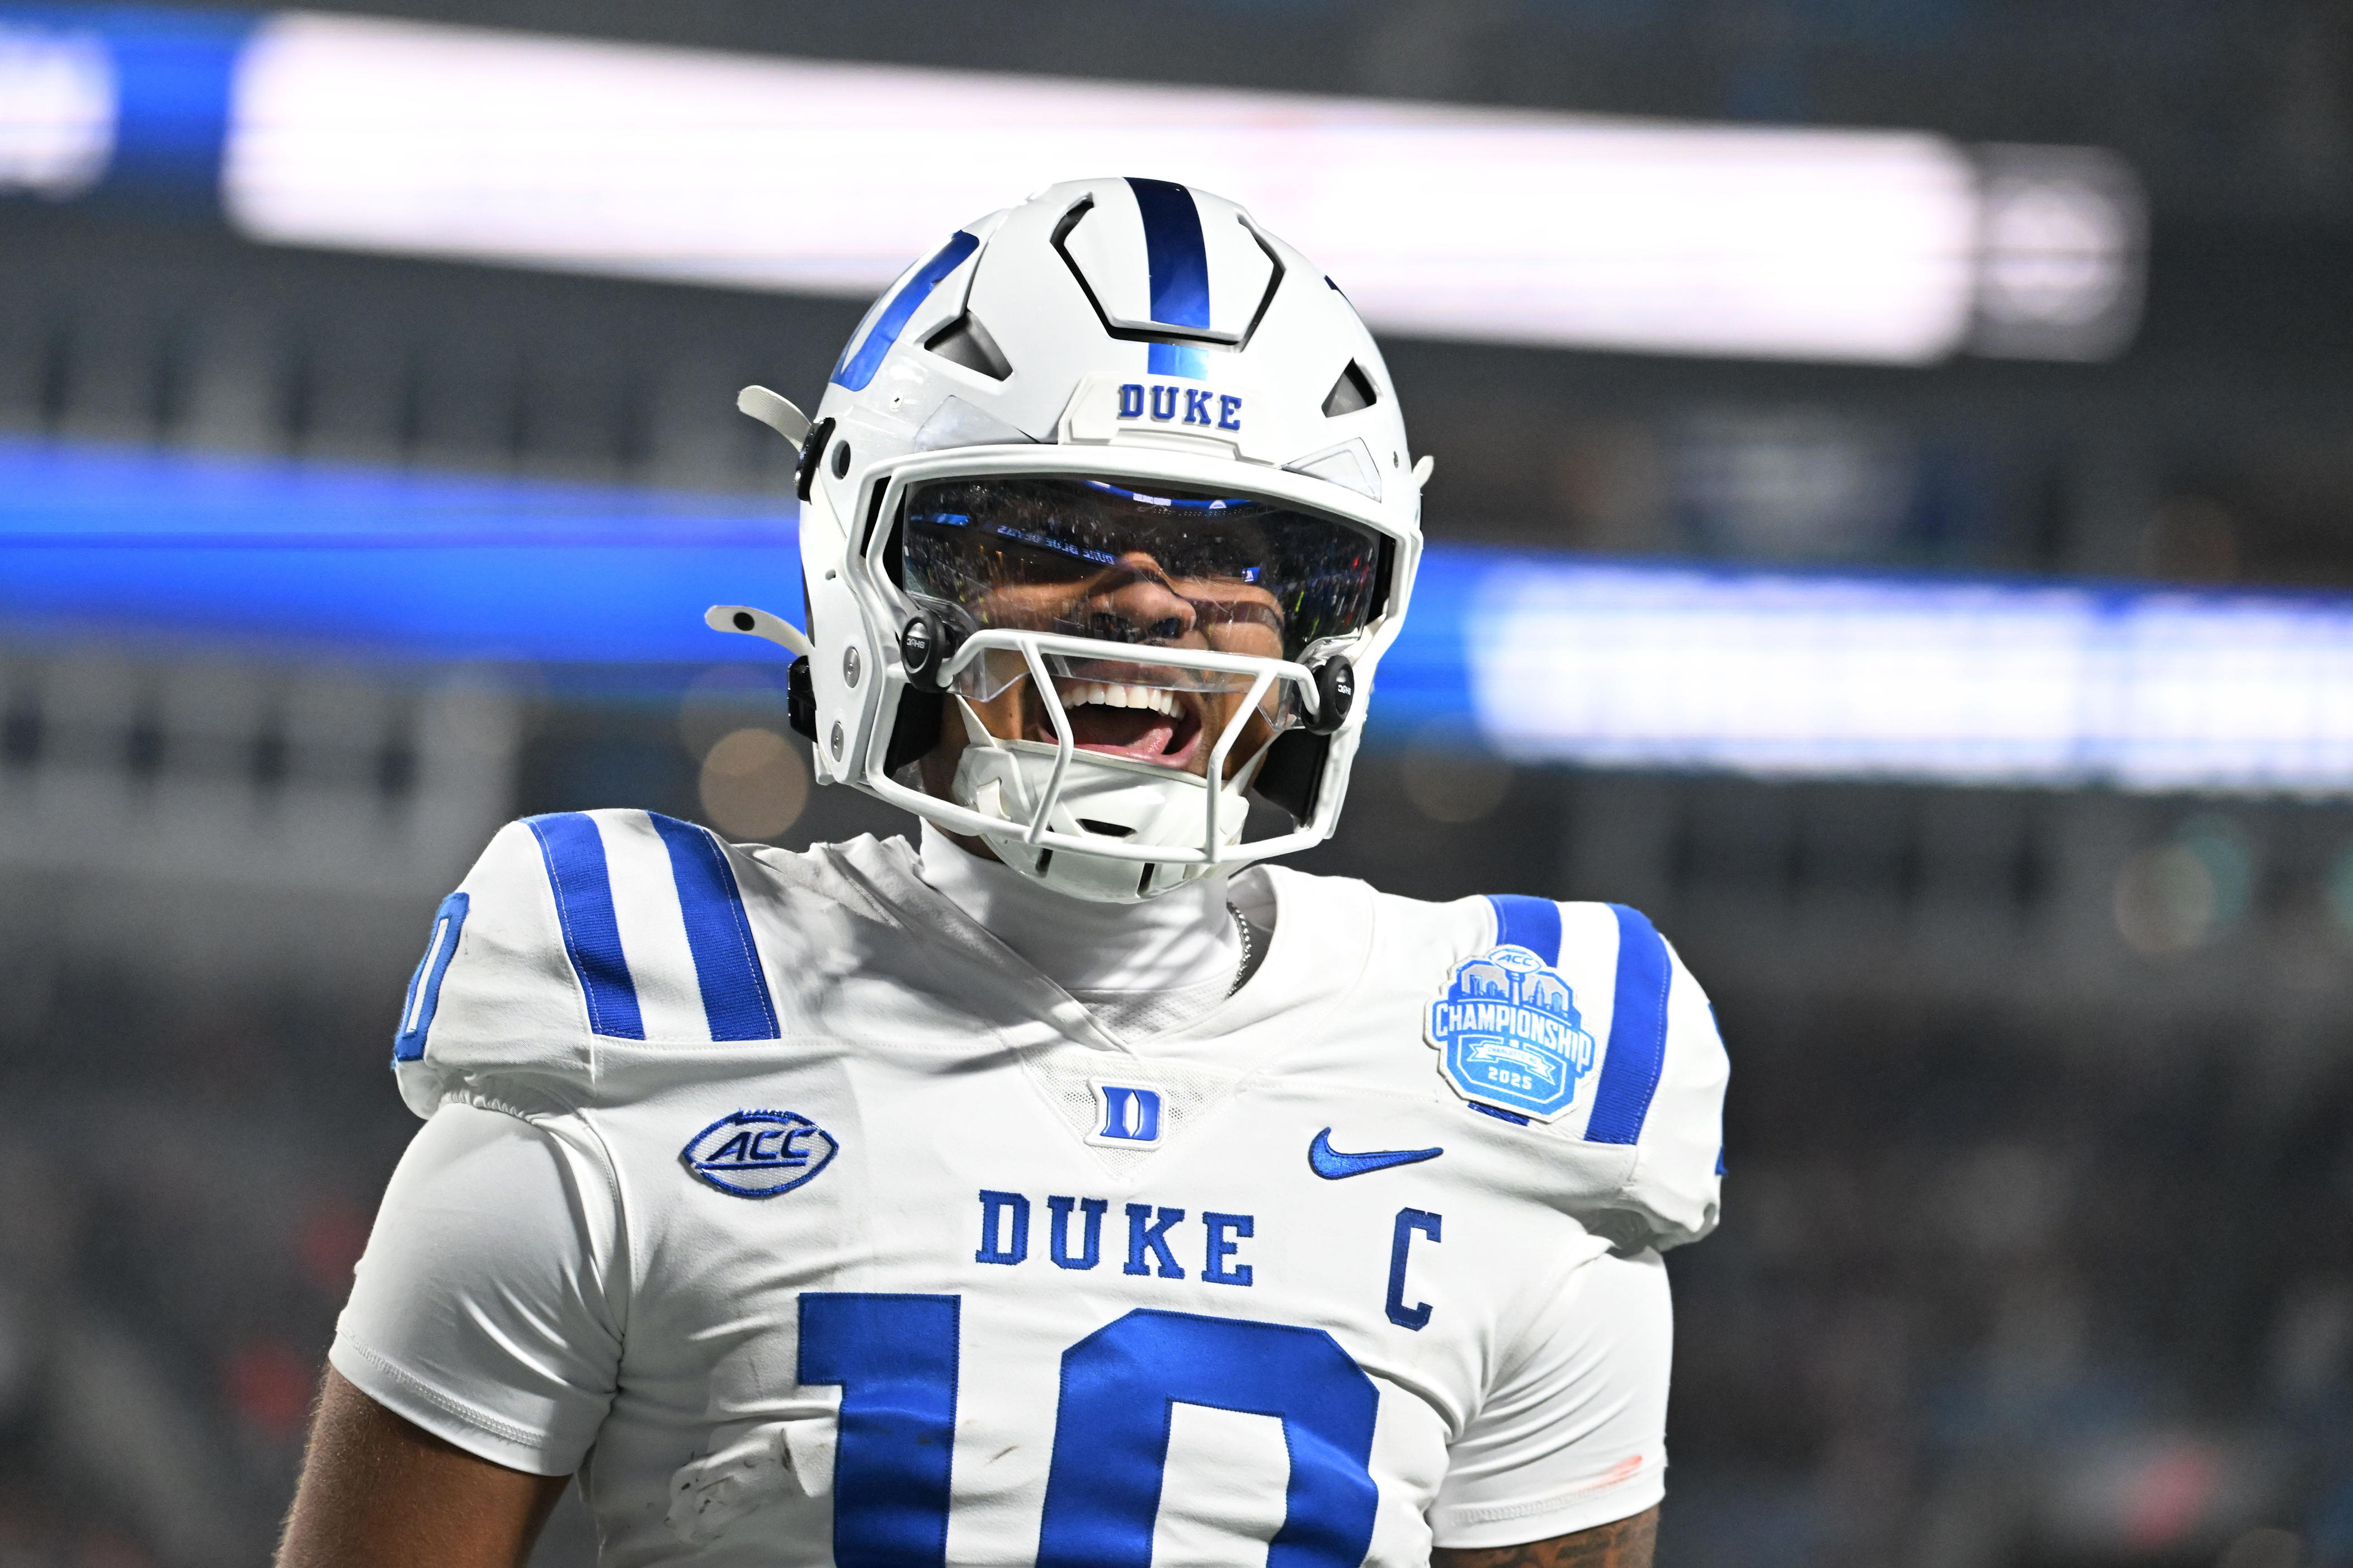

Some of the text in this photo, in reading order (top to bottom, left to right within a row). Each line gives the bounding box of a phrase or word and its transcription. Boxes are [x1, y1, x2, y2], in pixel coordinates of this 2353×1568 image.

[1119, 383, 1243, 431] DUKE
[1497, 954, 1534, 967] ACC
[1435, 1002, 1592, 1074] CHAMPIONSHIP
[1488, 1066, 1532, 1090] 2025
[1099, 1085, 1161, 1142] D
[705, 1127, 817, 1161] ACC
[975, 1189, 1255, 1287] DUKE
[1384, 1206, 1443, 1332] C
[797, 1292, 1380, 1568] 10
